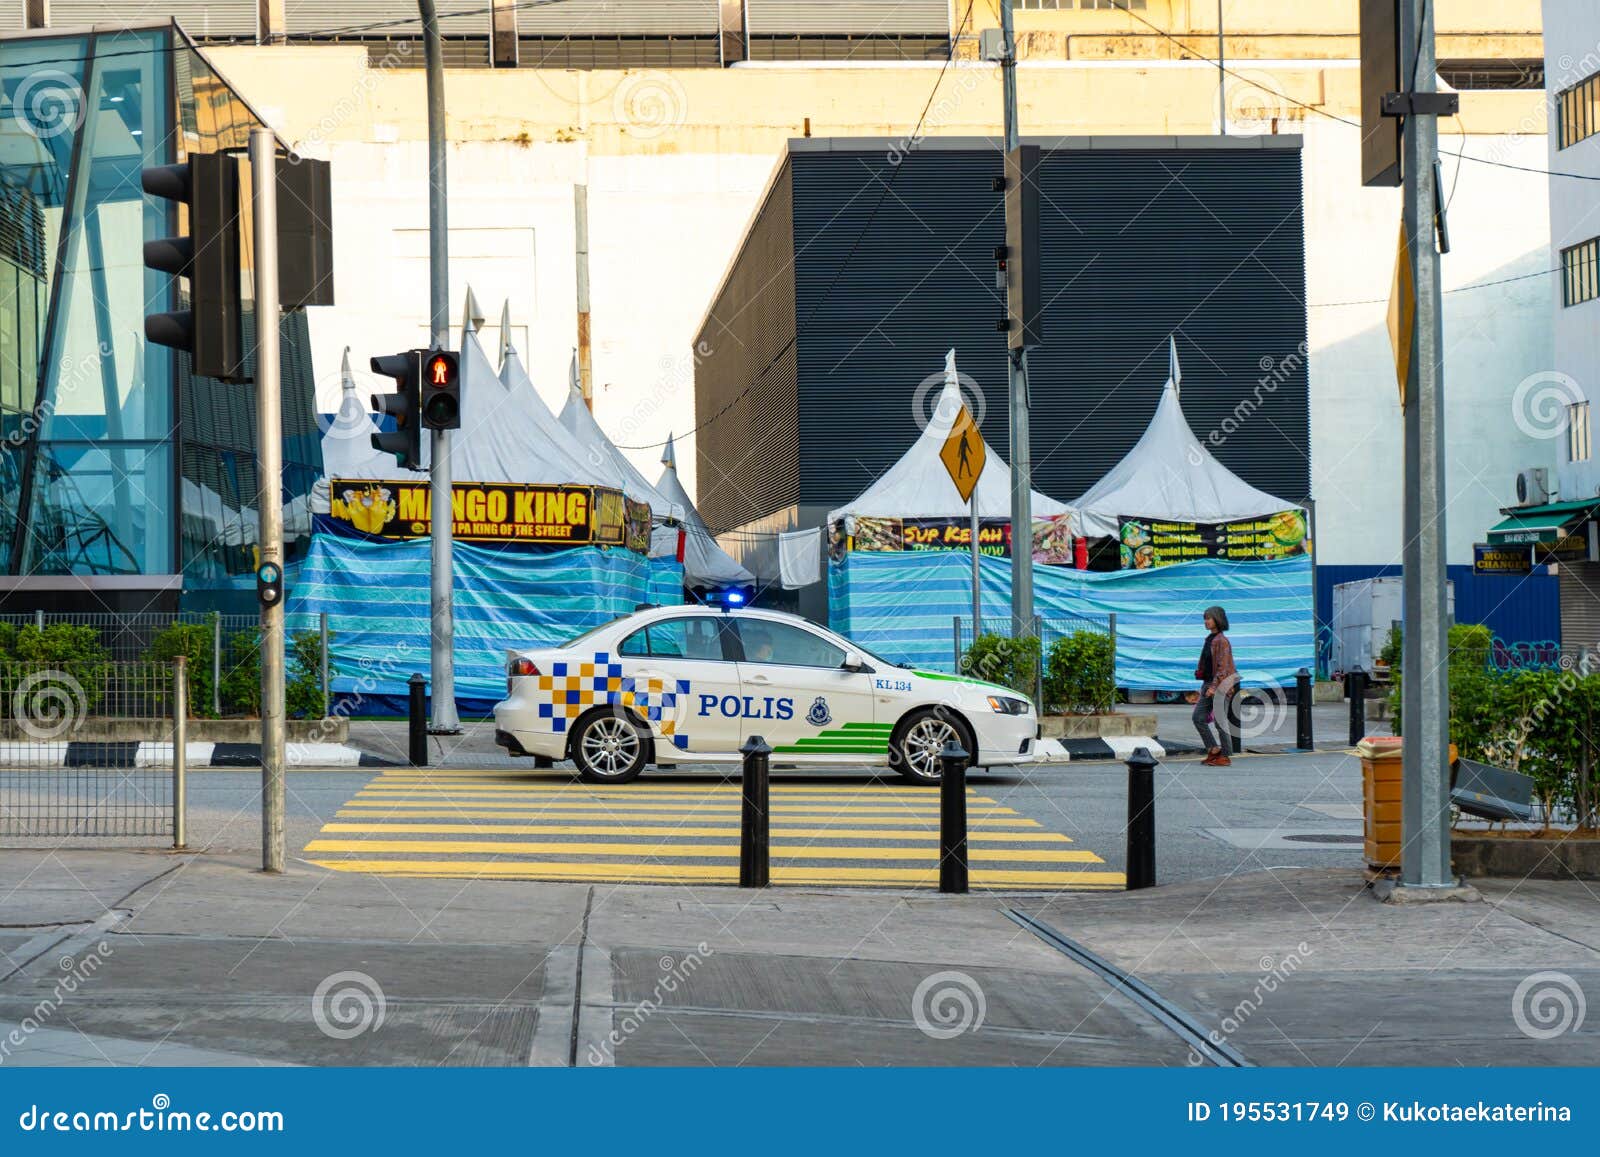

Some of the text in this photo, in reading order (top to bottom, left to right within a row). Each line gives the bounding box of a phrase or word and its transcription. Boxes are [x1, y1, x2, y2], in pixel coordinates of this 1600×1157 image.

[515, 491, 586, 525] KING
[457, 523, 471, 534] PA
[473, 523, 498, 535] KING
[499, 525, 513, 535] OF
[515, 525, 533, 536] THE
[535, 525, 573, 537] STREET
[944, 526, 1003, 543] KEAH
[876, 679, 912, 692] KL 134
[697, 694, 794, 720] POLIS
